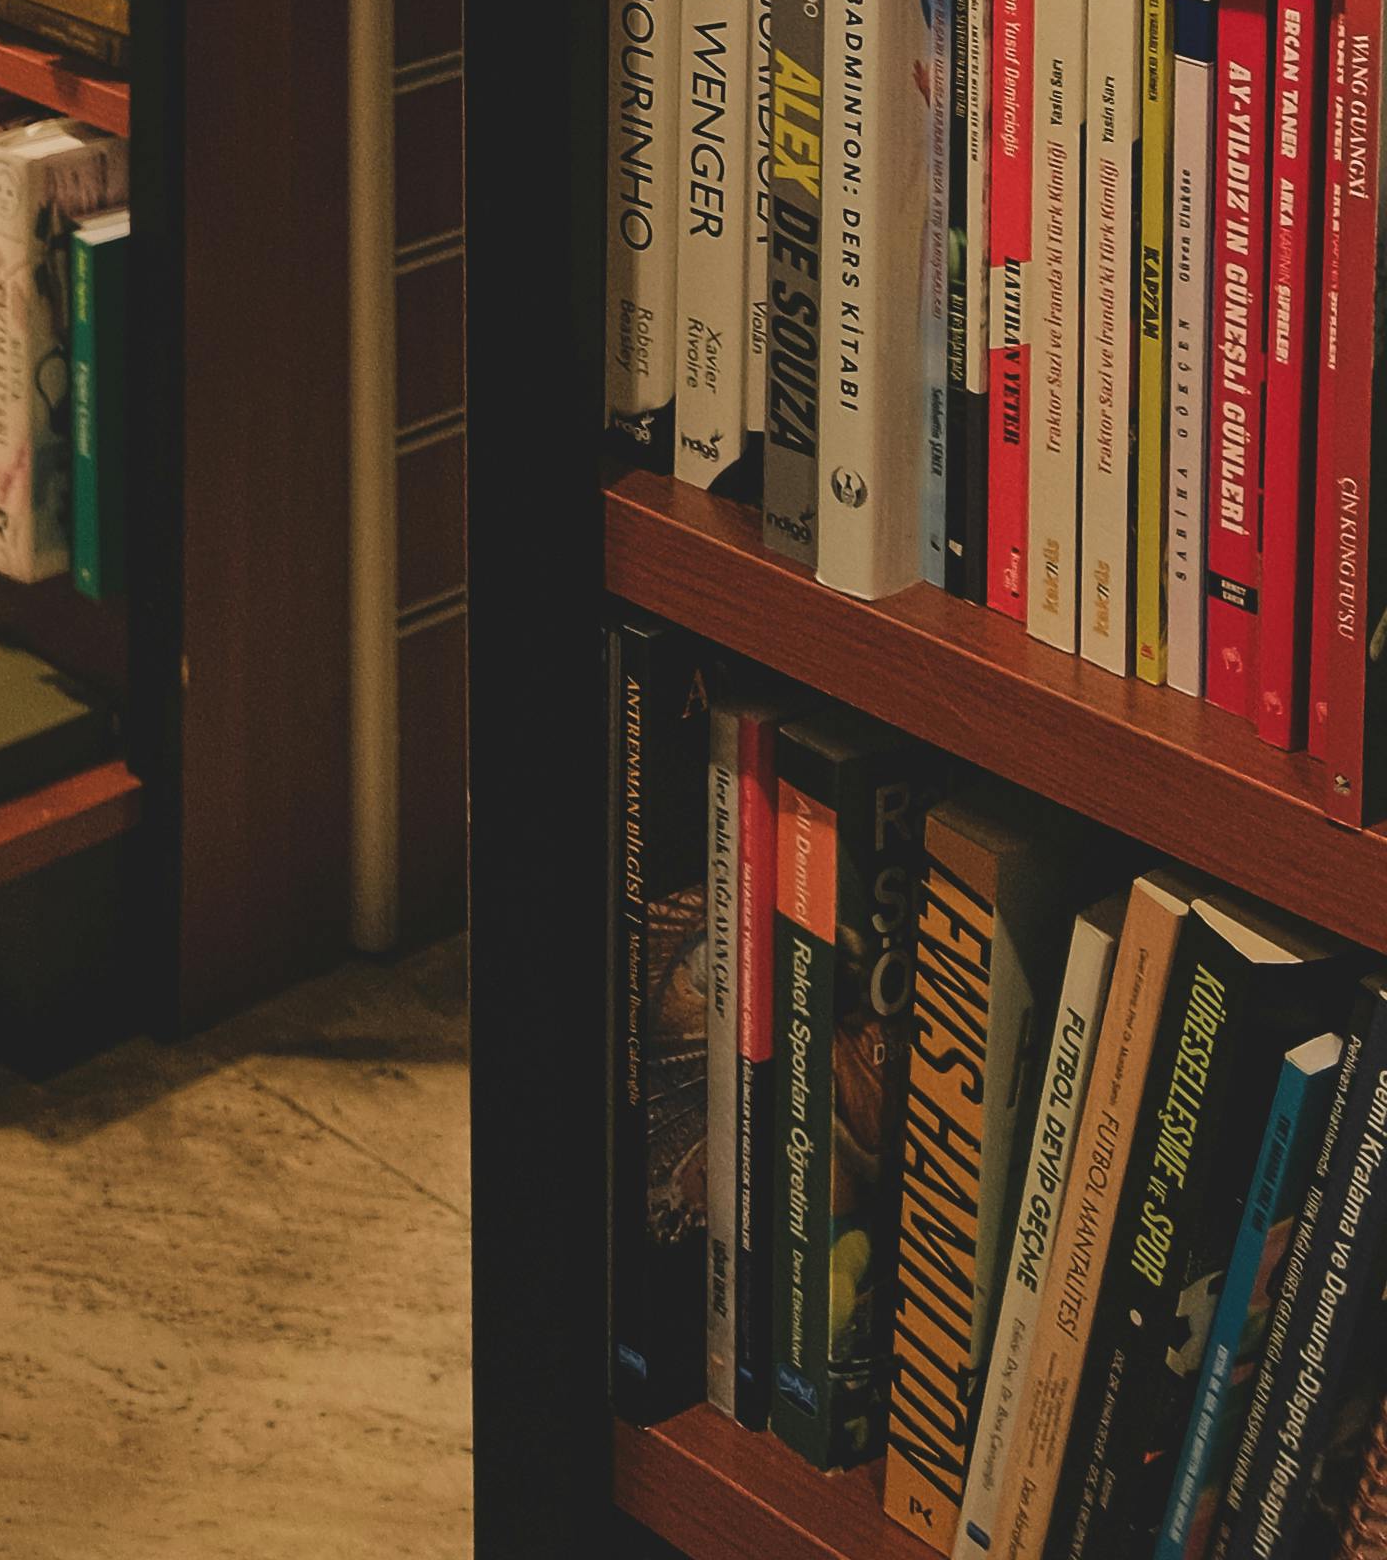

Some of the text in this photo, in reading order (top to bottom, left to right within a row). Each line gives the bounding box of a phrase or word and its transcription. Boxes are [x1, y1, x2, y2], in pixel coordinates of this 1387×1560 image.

[1003, 21, 1021, 65] Yusuf
[1283, 8, 1301, 81] ERCAN
[1349, 33, 1370, 97] WANG
[690, 20, 728, 238] WENGER
[1001, 67, 1020, 158] Demircioğlu
[1280, 89, 1298, 160] TANER
[770, 48, 822, 459] ALEX DE SOUZA
[841, 208, 861, 287] DERS
[1218, 61, 1252, 536] AY-YILDIZ'IN GÜNEŞLİ GÜNLERİ
[636, 307, 654, 377] Robert
[685, 317, 703, 389] Rivoire
[703, 328, 722, 394] Xavier
[839, 301, 865, 413] KİTABI
[1003, 370, 1021, 445] YETER
[1337, 477, 1361, 515] ÇİN
[1339, 517, 1357, 577] KUNG
[625, 675, 641, 818] ANTRENMAN
[1015, 1008, 1086, 1293] FUTBOL DEYİP GEÇME
[1129, 964, 1228, 1287] KÜRESELLEŞME VE SPOR
[1338, 1132, 1380, 1238] Kiralama
[1055, 1111, 1119, 1342] FUTBOL MANTALİTESİ
[1330, 1242, 1352, 1269] ve
[887, 1092, 982, 1510] HAMILTON
